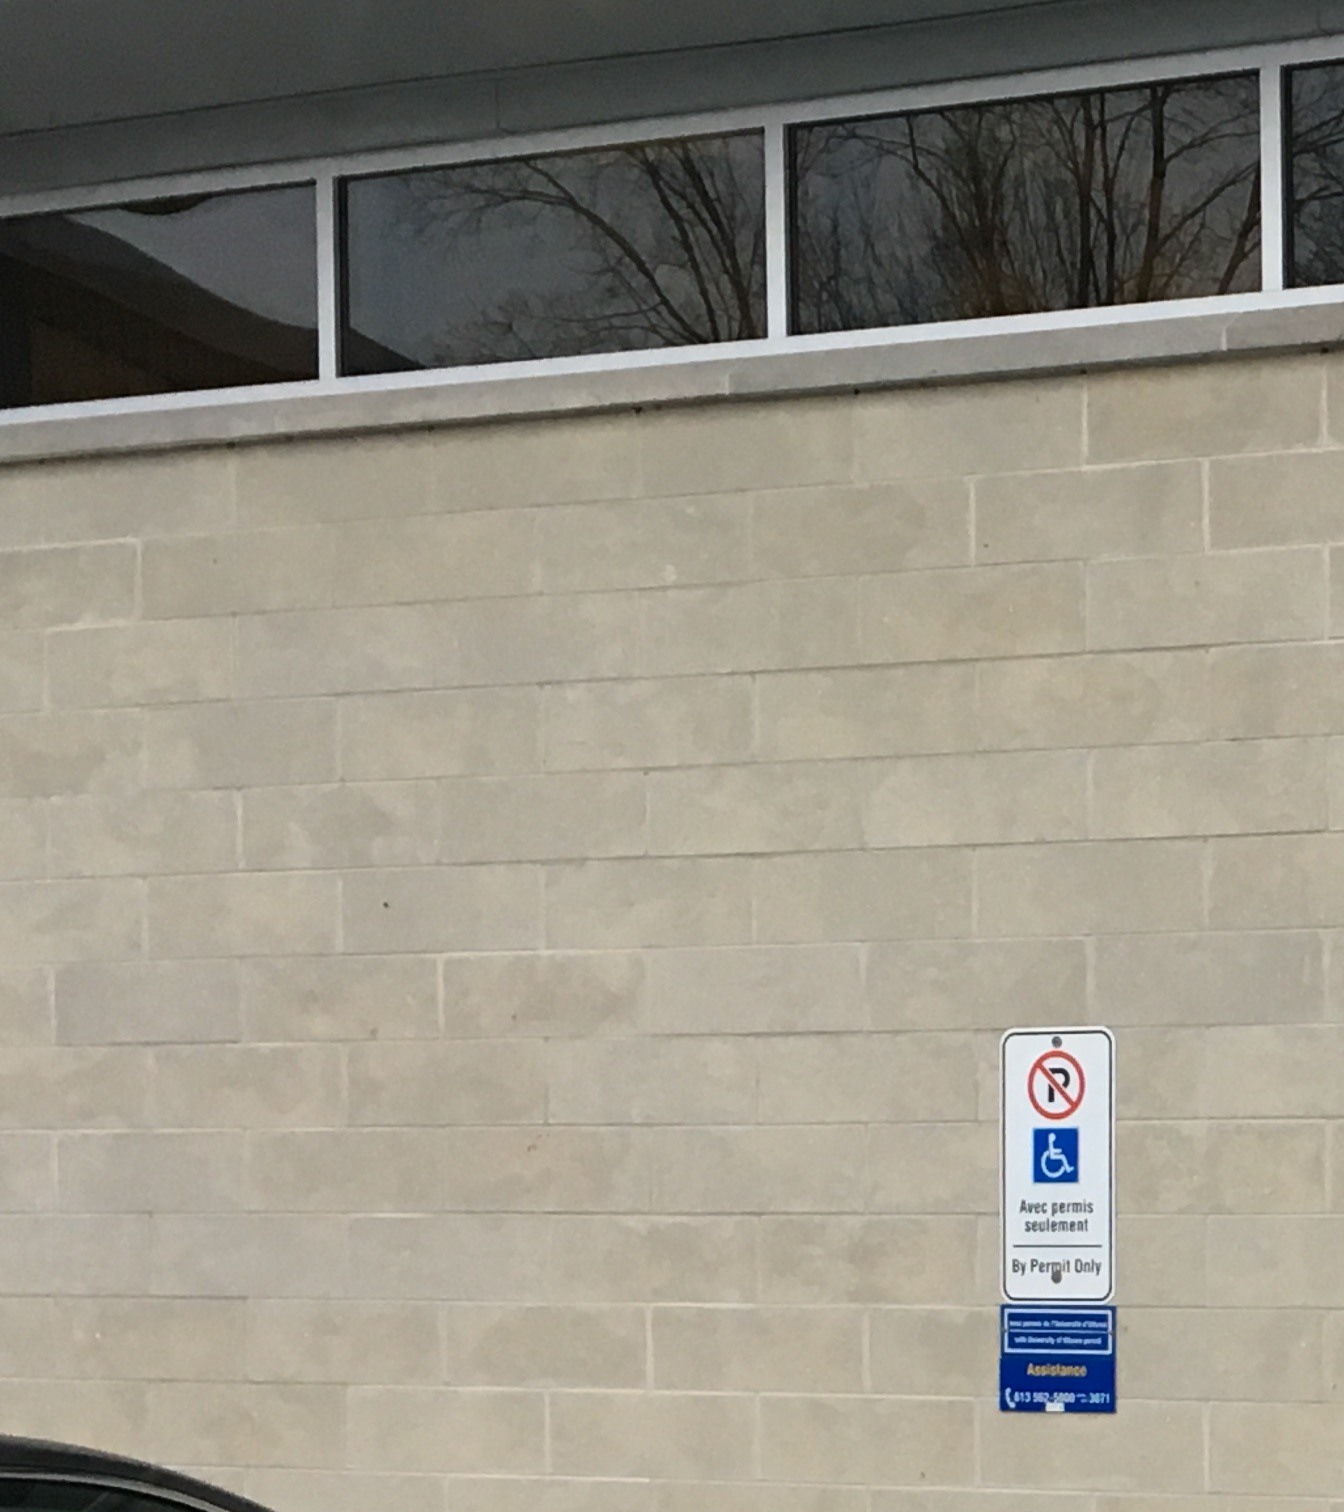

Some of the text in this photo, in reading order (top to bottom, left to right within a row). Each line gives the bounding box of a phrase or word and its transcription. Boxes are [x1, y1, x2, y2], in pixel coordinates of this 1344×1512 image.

[1019, 1199, 1094, 1216] Avec permis
[1024, 1218, 1089, 1232] seulement
[1012, 1258, 1102, 1276] By Permit Only
